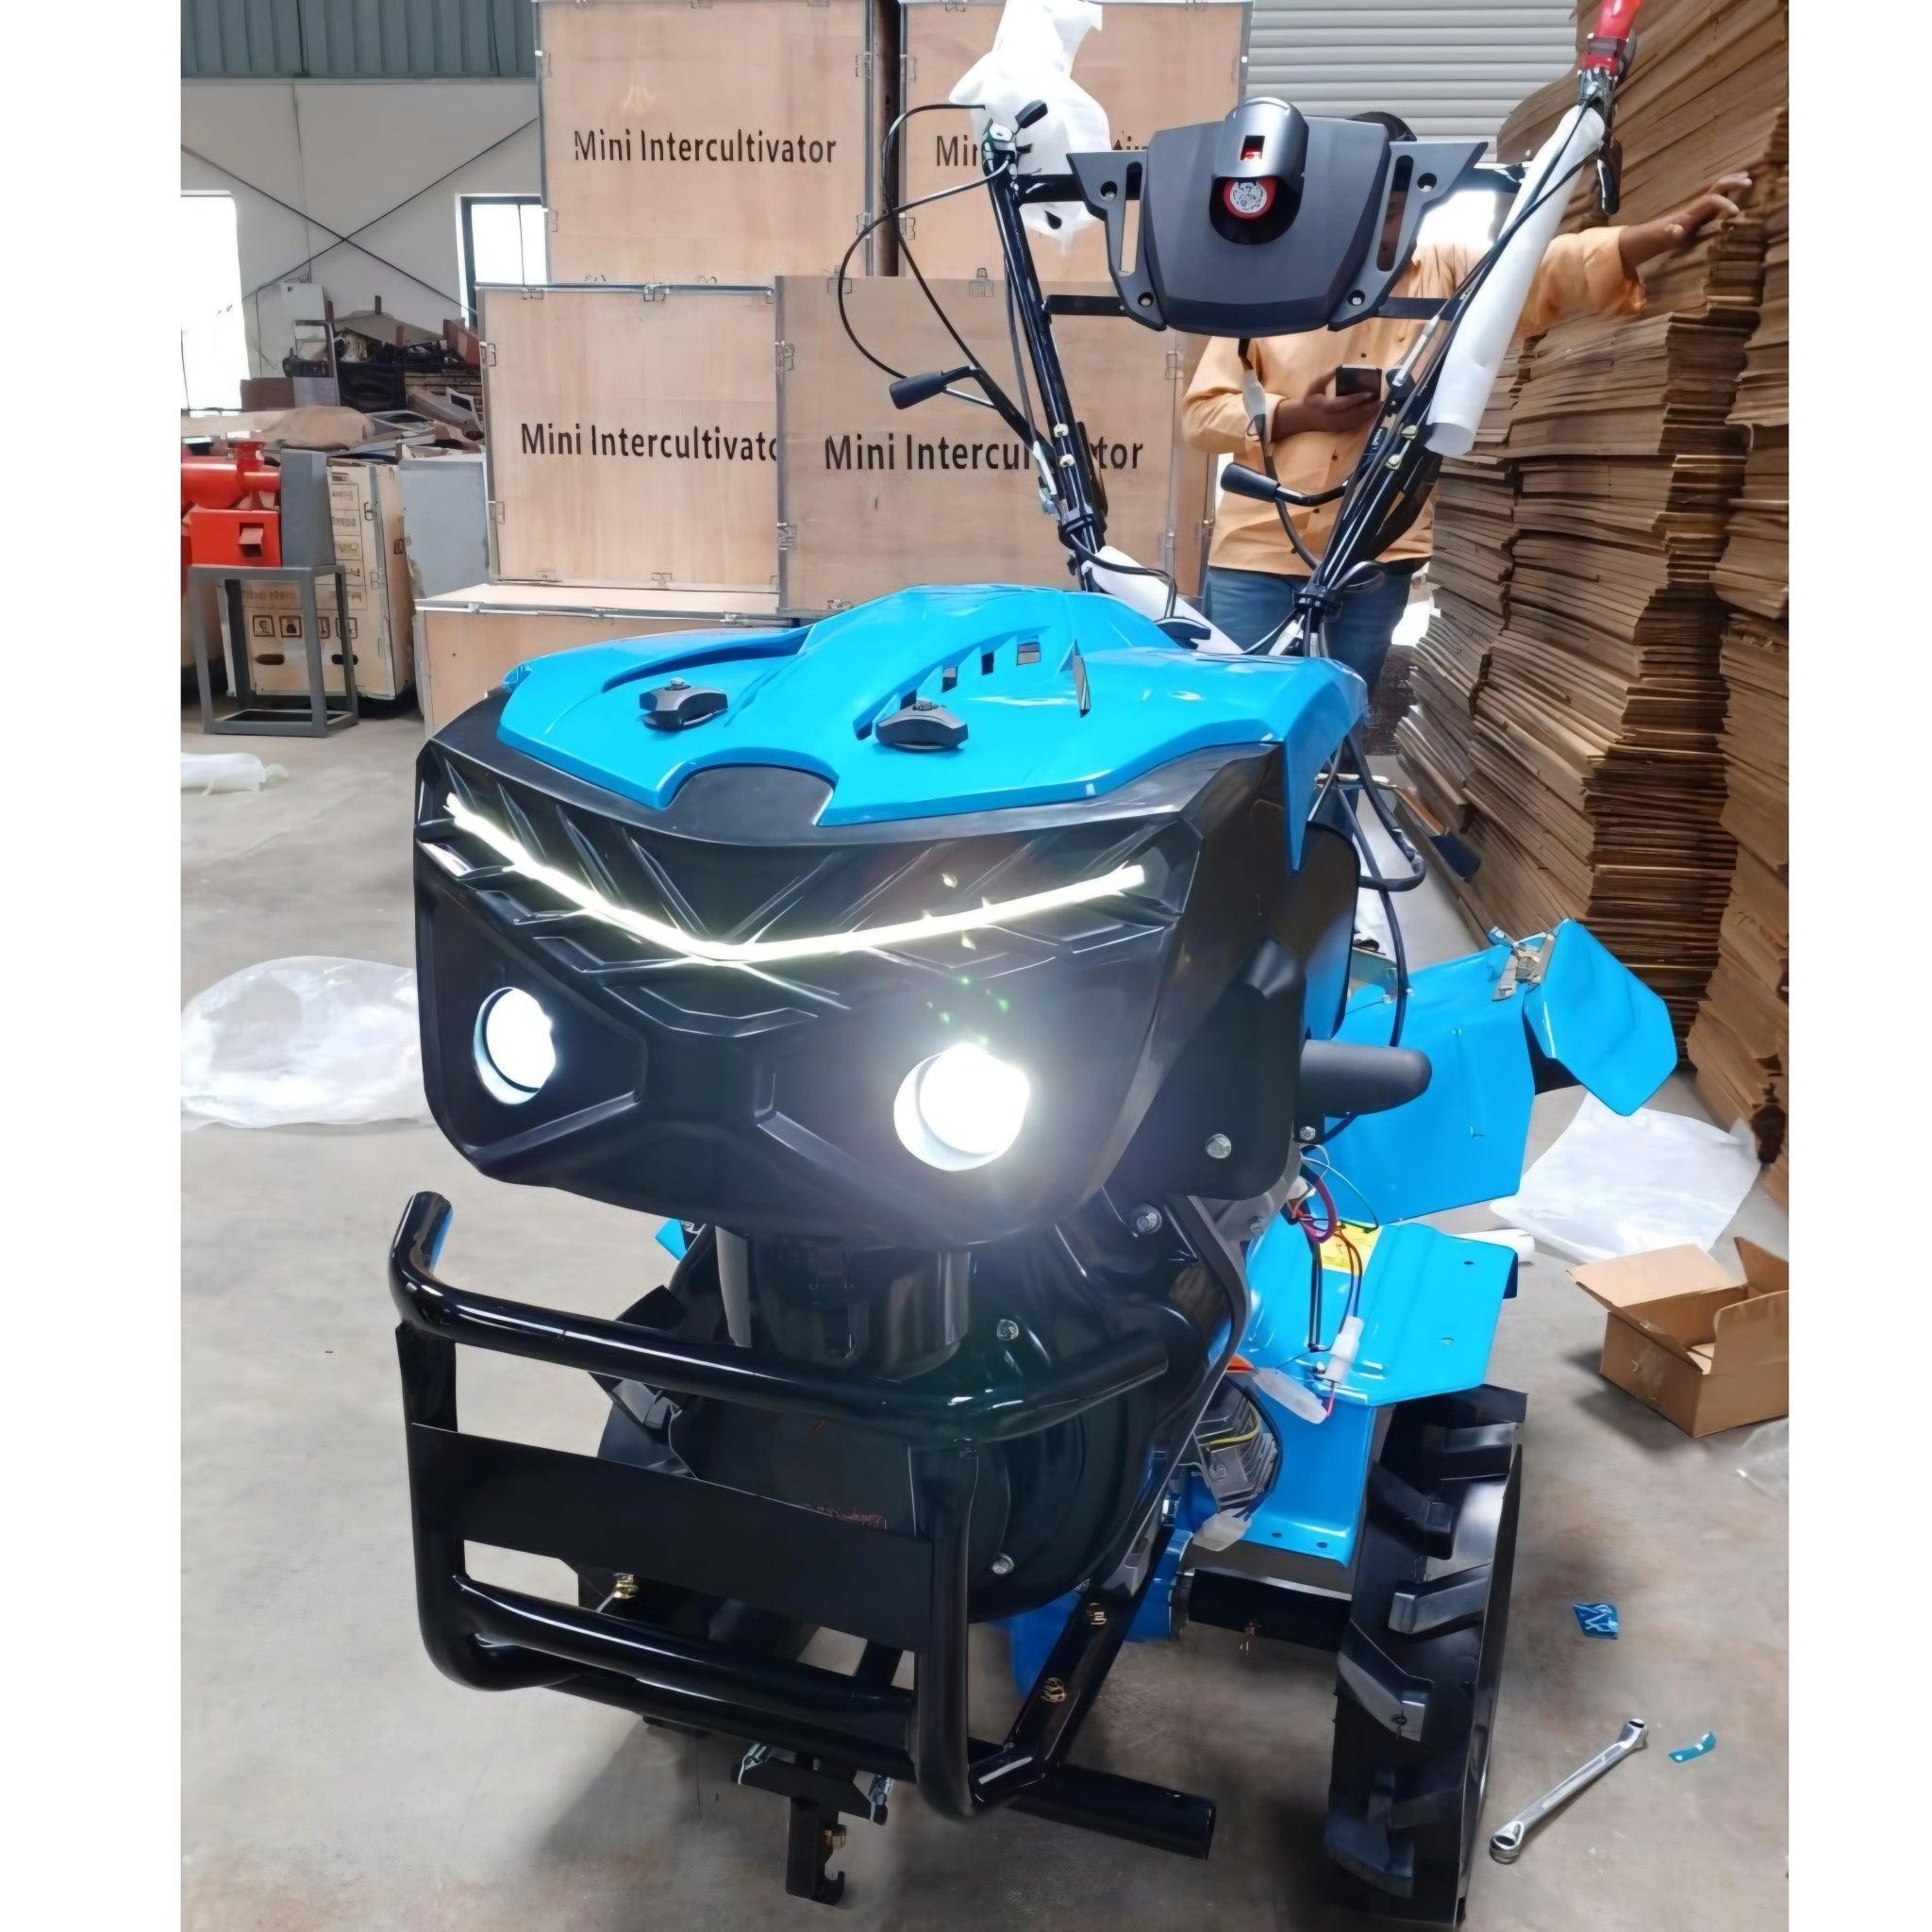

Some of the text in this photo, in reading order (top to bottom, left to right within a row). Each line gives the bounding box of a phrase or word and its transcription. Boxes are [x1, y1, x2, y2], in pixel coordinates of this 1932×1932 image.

[574, 128, 837, 163] Mini Intercultivator
[521, 423, 582, 455] Mini
[824, 432, 895, 470] Mini
